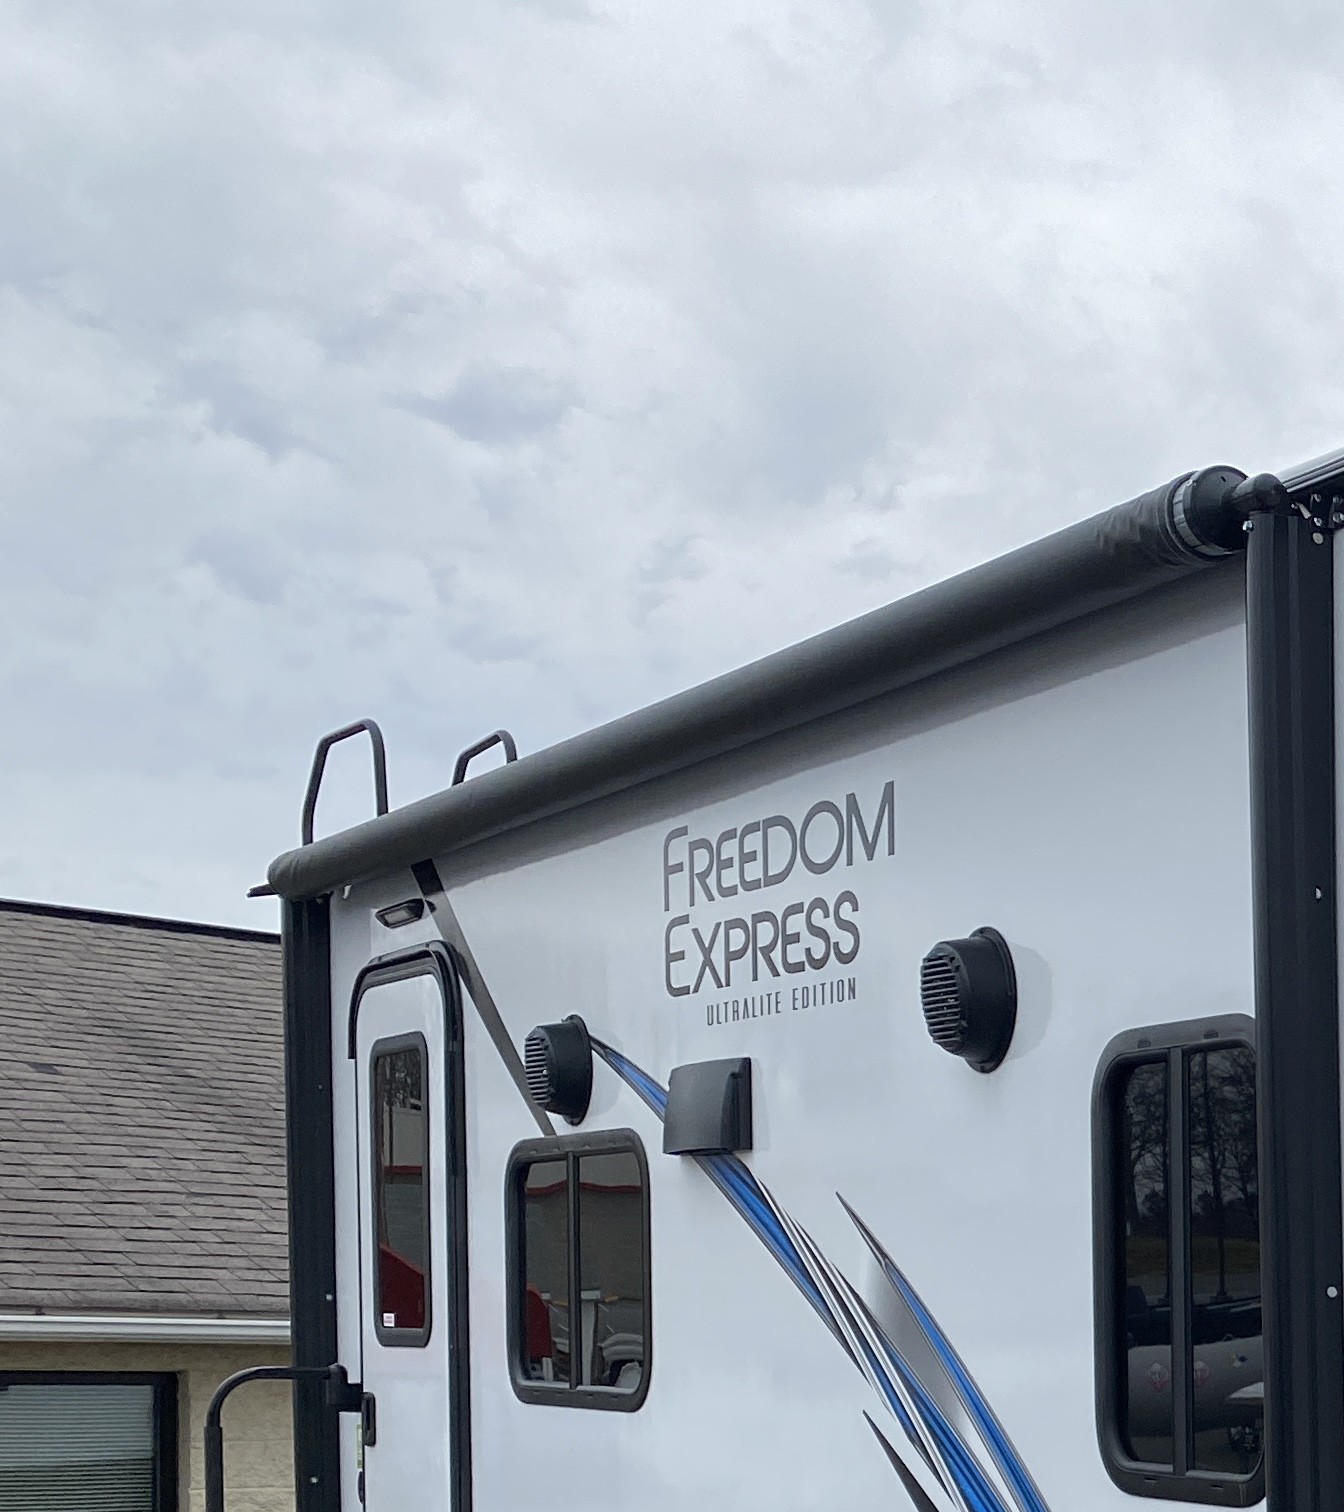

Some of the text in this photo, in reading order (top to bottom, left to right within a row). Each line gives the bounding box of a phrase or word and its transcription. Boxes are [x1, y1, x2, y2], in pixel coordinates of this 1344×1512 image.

[662, 779, 896, 913] FREEDOM
[663, 889, 861, 998] EXPRESS
[706, 976, 857, 1027] ULTRALITE EDITION
